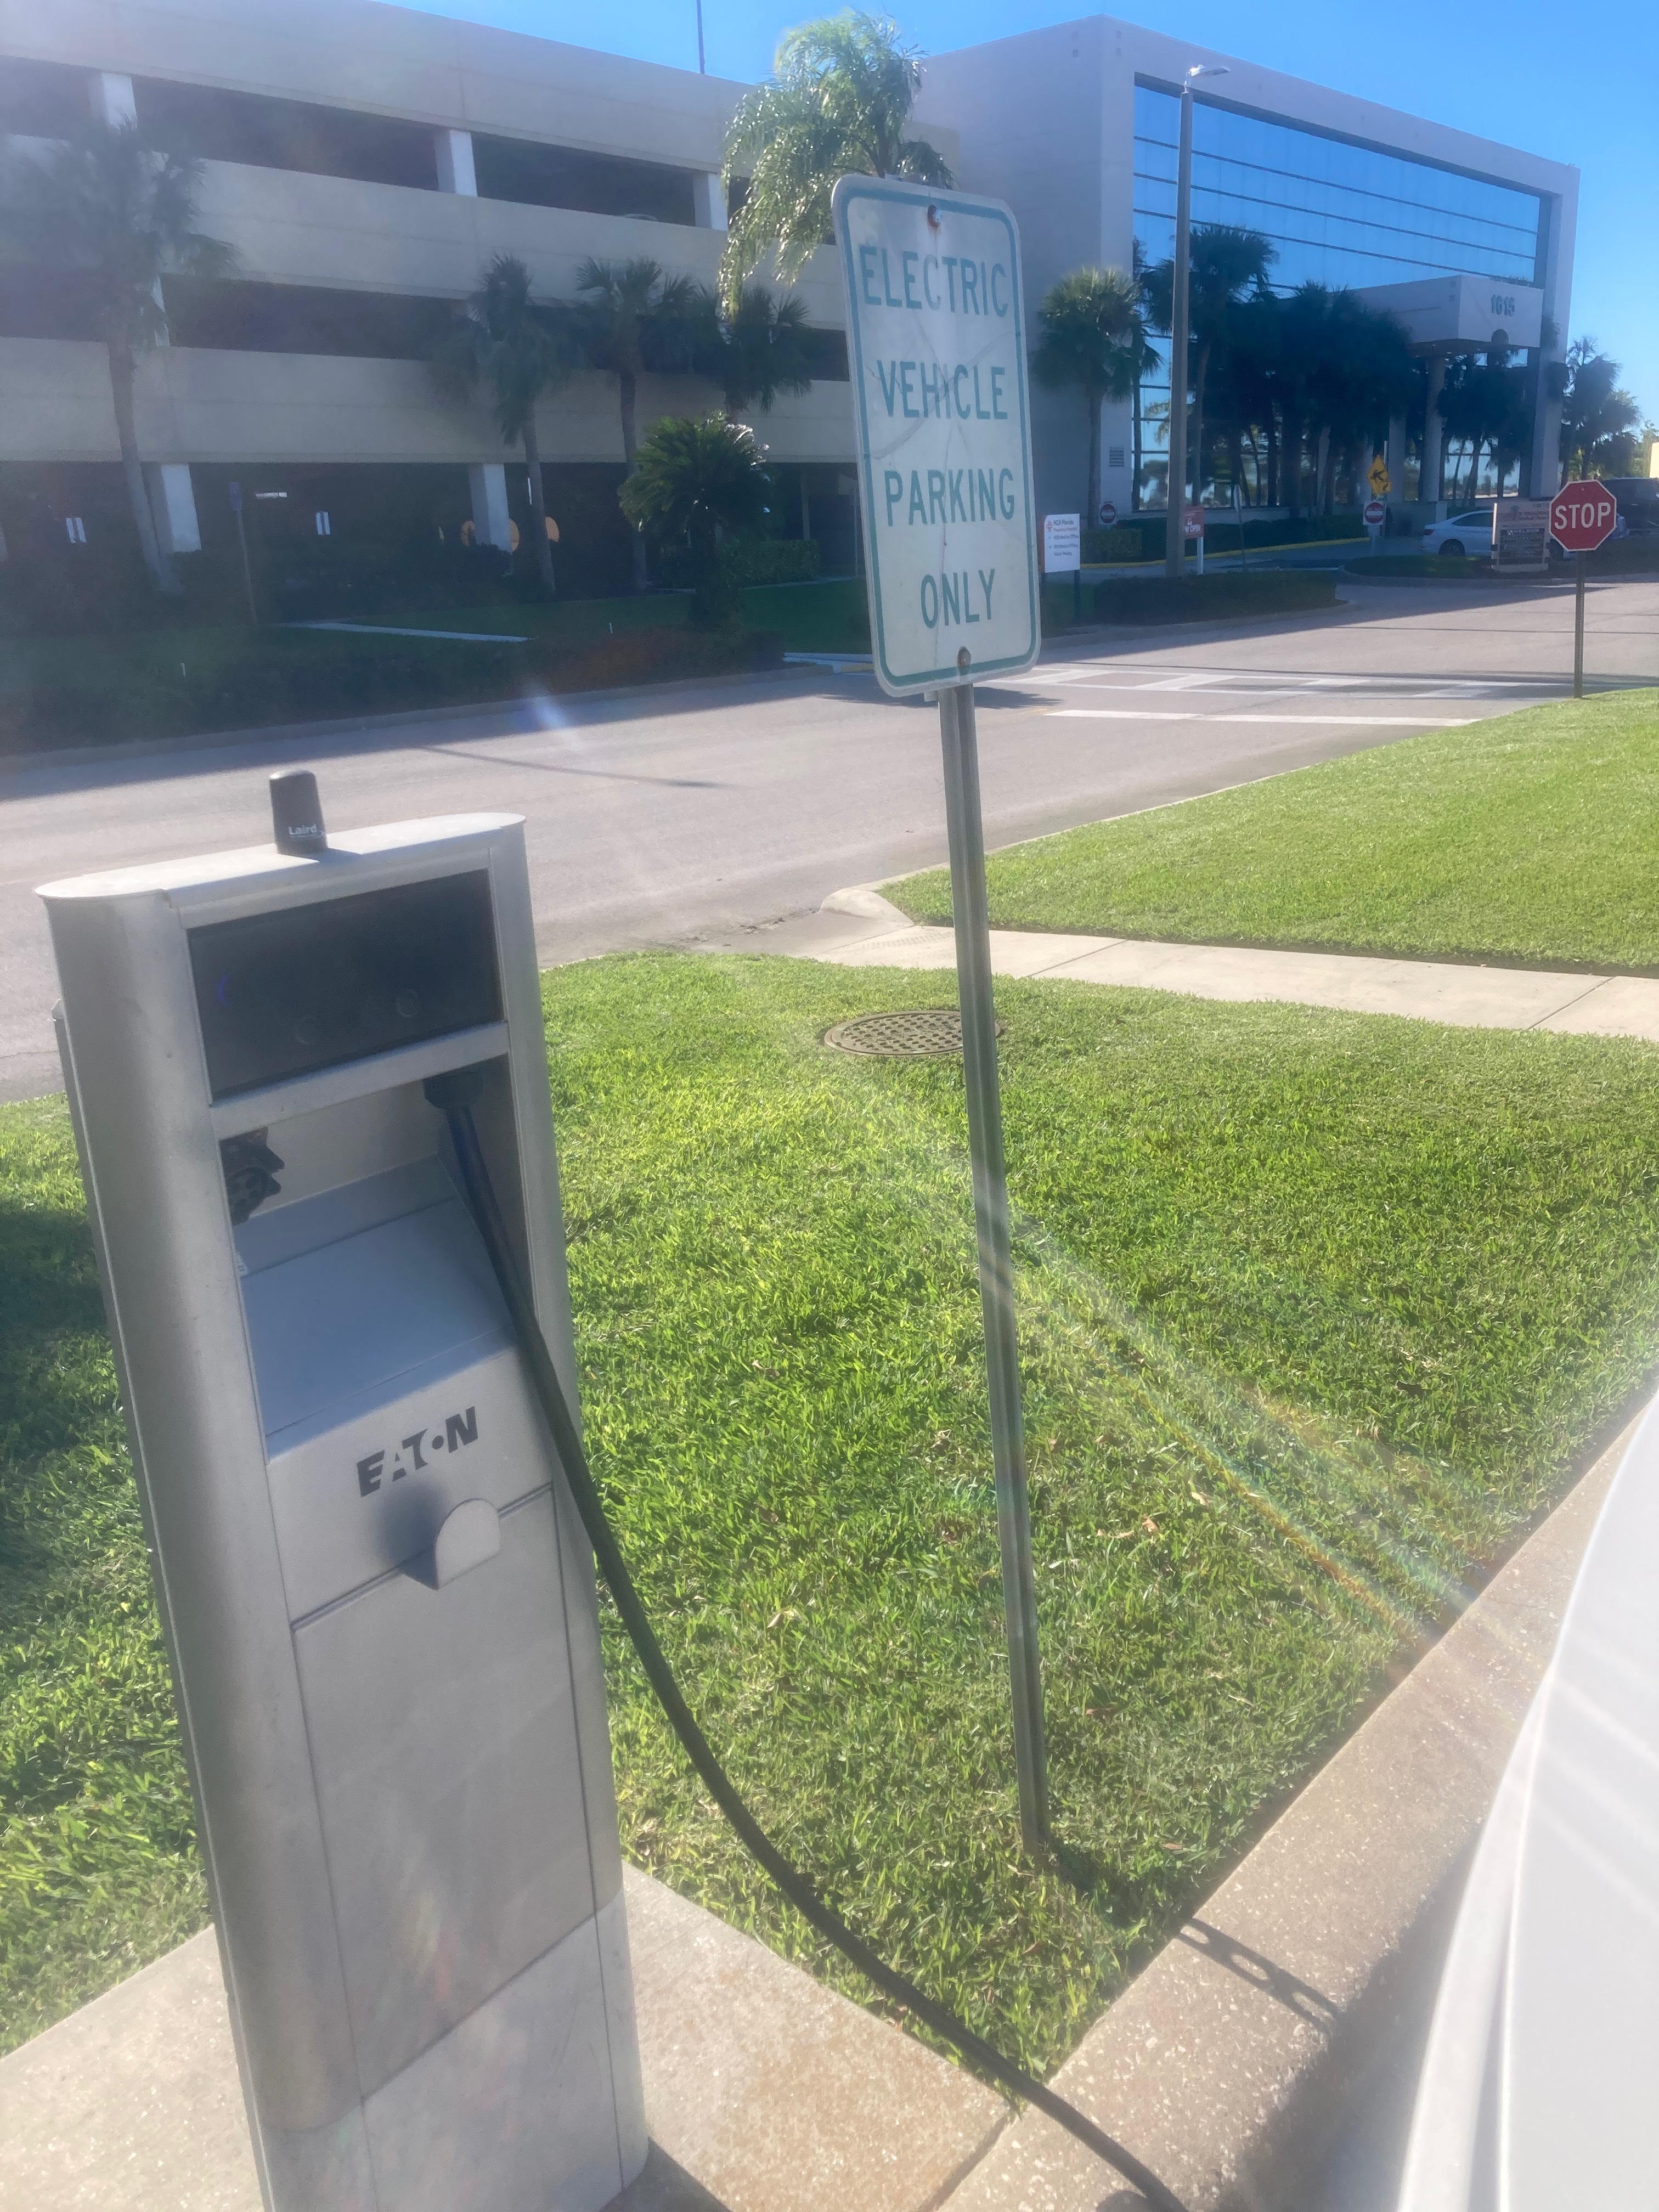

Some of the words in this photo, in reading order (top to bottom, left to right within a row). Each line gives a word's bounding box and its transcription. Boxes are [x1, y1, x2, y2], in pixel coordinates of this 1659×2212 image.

[859, 245, 1008, 318] ELECTRIC
[877, 359, 1008, 420] VEHICLE
[884, 468, 1015, 527] PARKING
[1554, 502, 1611, 531] STOP
[921, 568, 995, 629] ONLY
[289, 824, 317, 835] Laird
[357, 1406, 478, 1498] EATON
